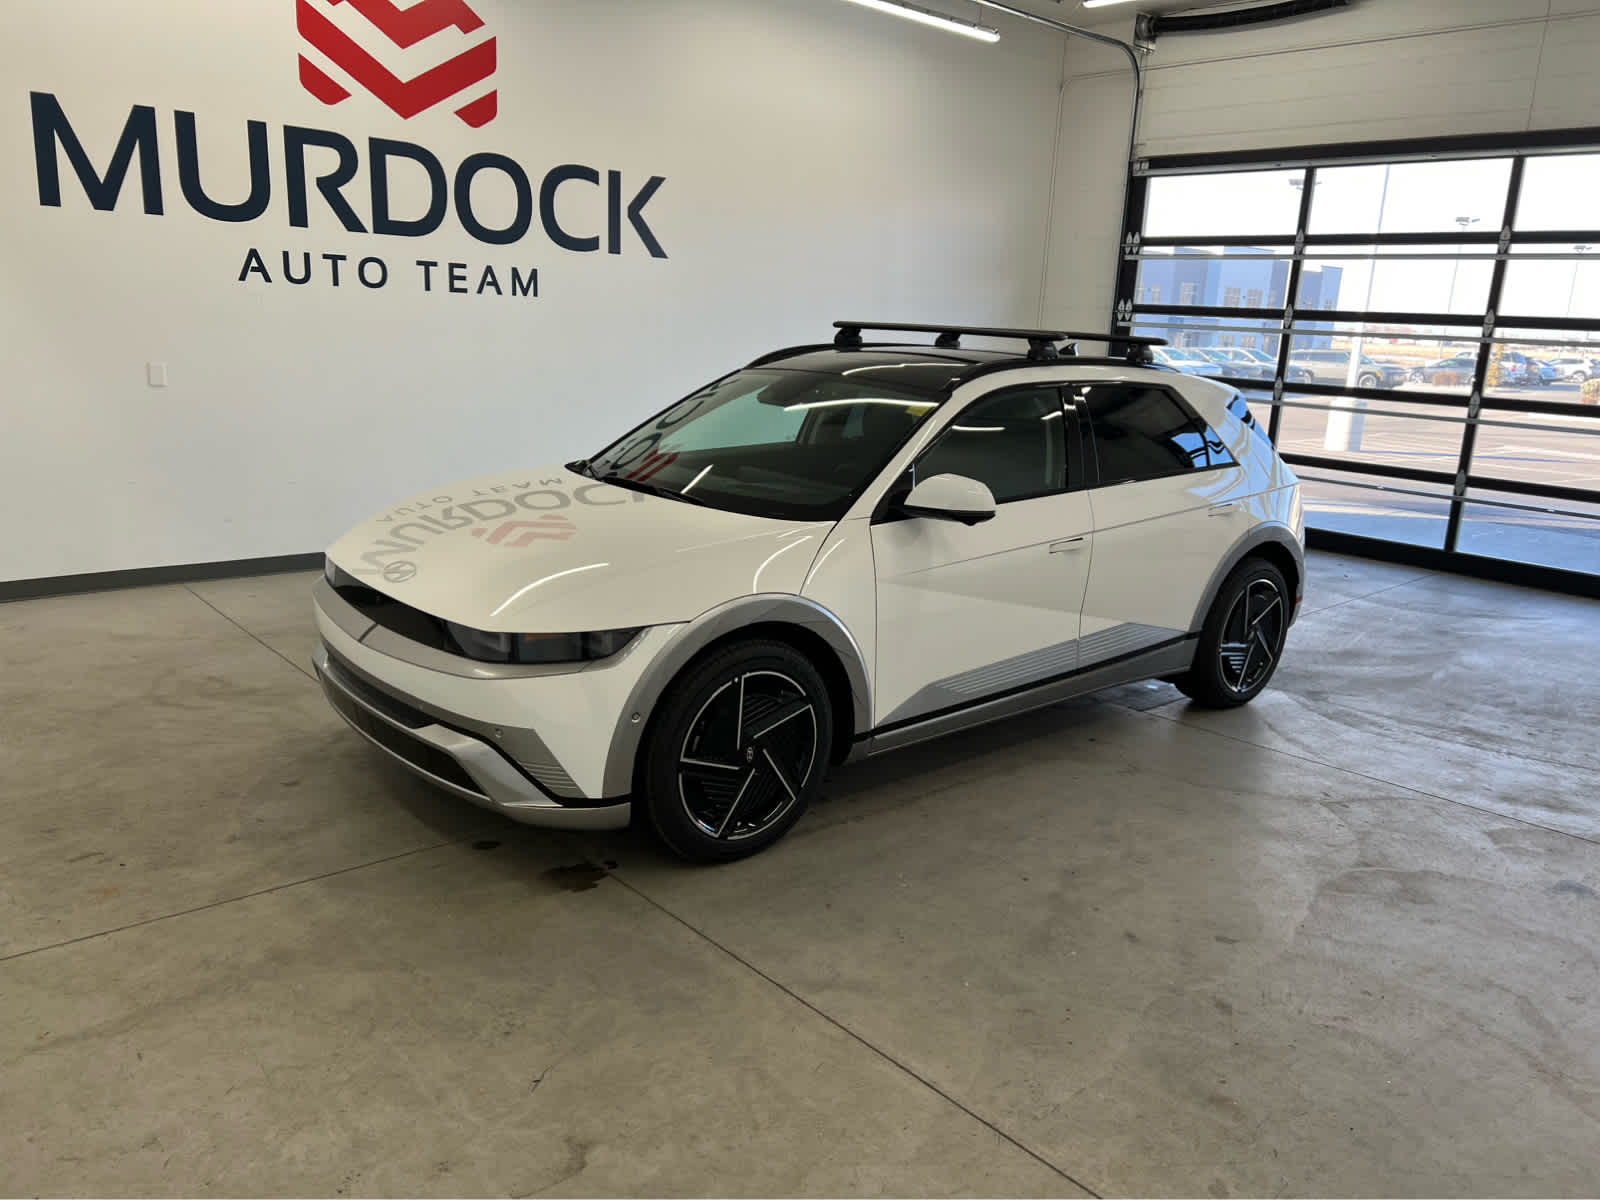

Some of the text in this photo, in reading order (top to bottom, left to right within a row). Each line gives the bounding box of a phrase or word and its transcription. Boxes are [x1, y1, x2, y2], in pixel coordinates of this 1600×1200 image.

[30, 91, 667, 258] MURDOCK
[239, 248, 538, 297] AUTO TEAM
